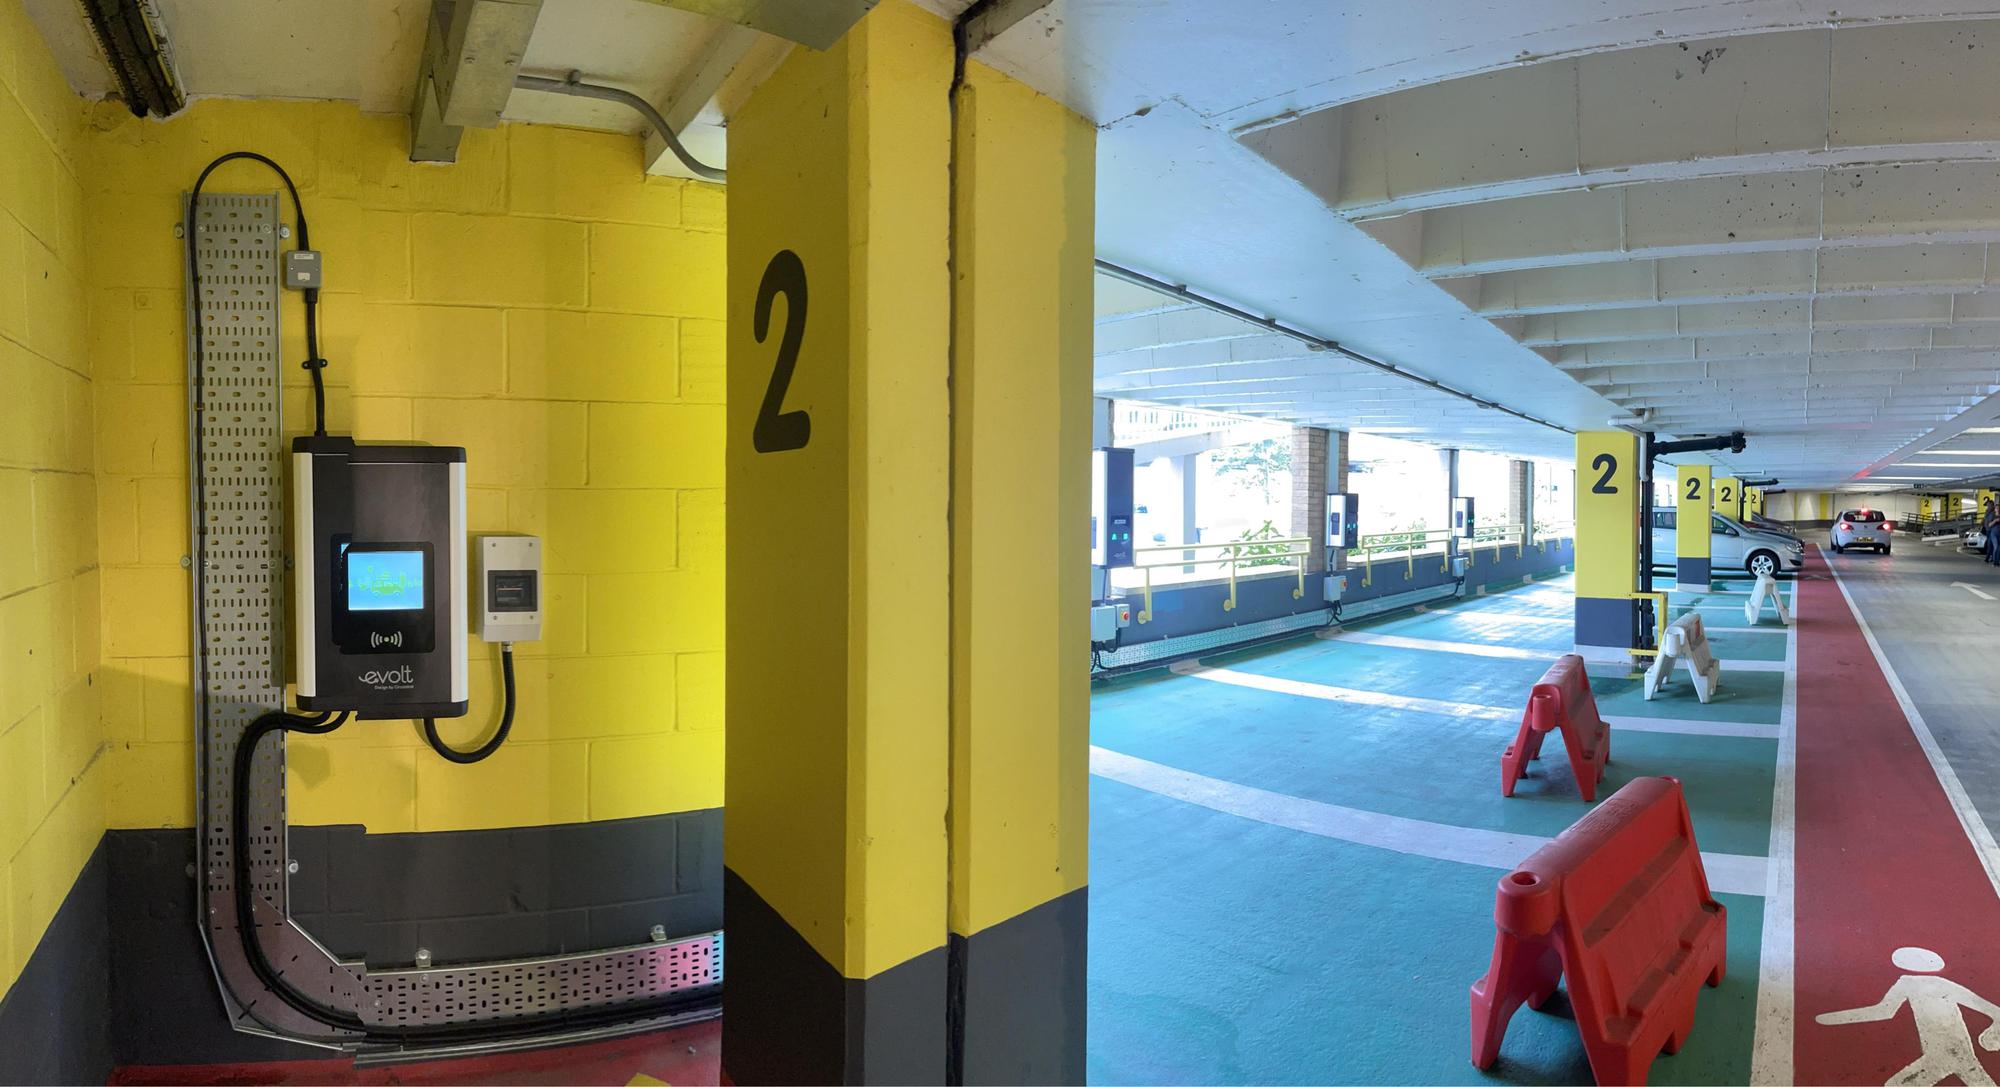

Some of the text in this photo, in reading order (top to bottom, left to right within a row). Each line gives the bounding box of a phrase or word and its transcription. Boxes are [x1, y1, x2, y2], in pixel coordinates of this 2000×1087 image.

[753, 249, 811, 453] 2
[1592, 453, 1618, 494] 2
[1686, 477, 1701, 500] 2
[1721, 487, 1732, 502] 2
[1751, 494, 1757, 504] 2
[1953, 497, 1959, 506] 2
[358, 664, 414, 685] evolt
